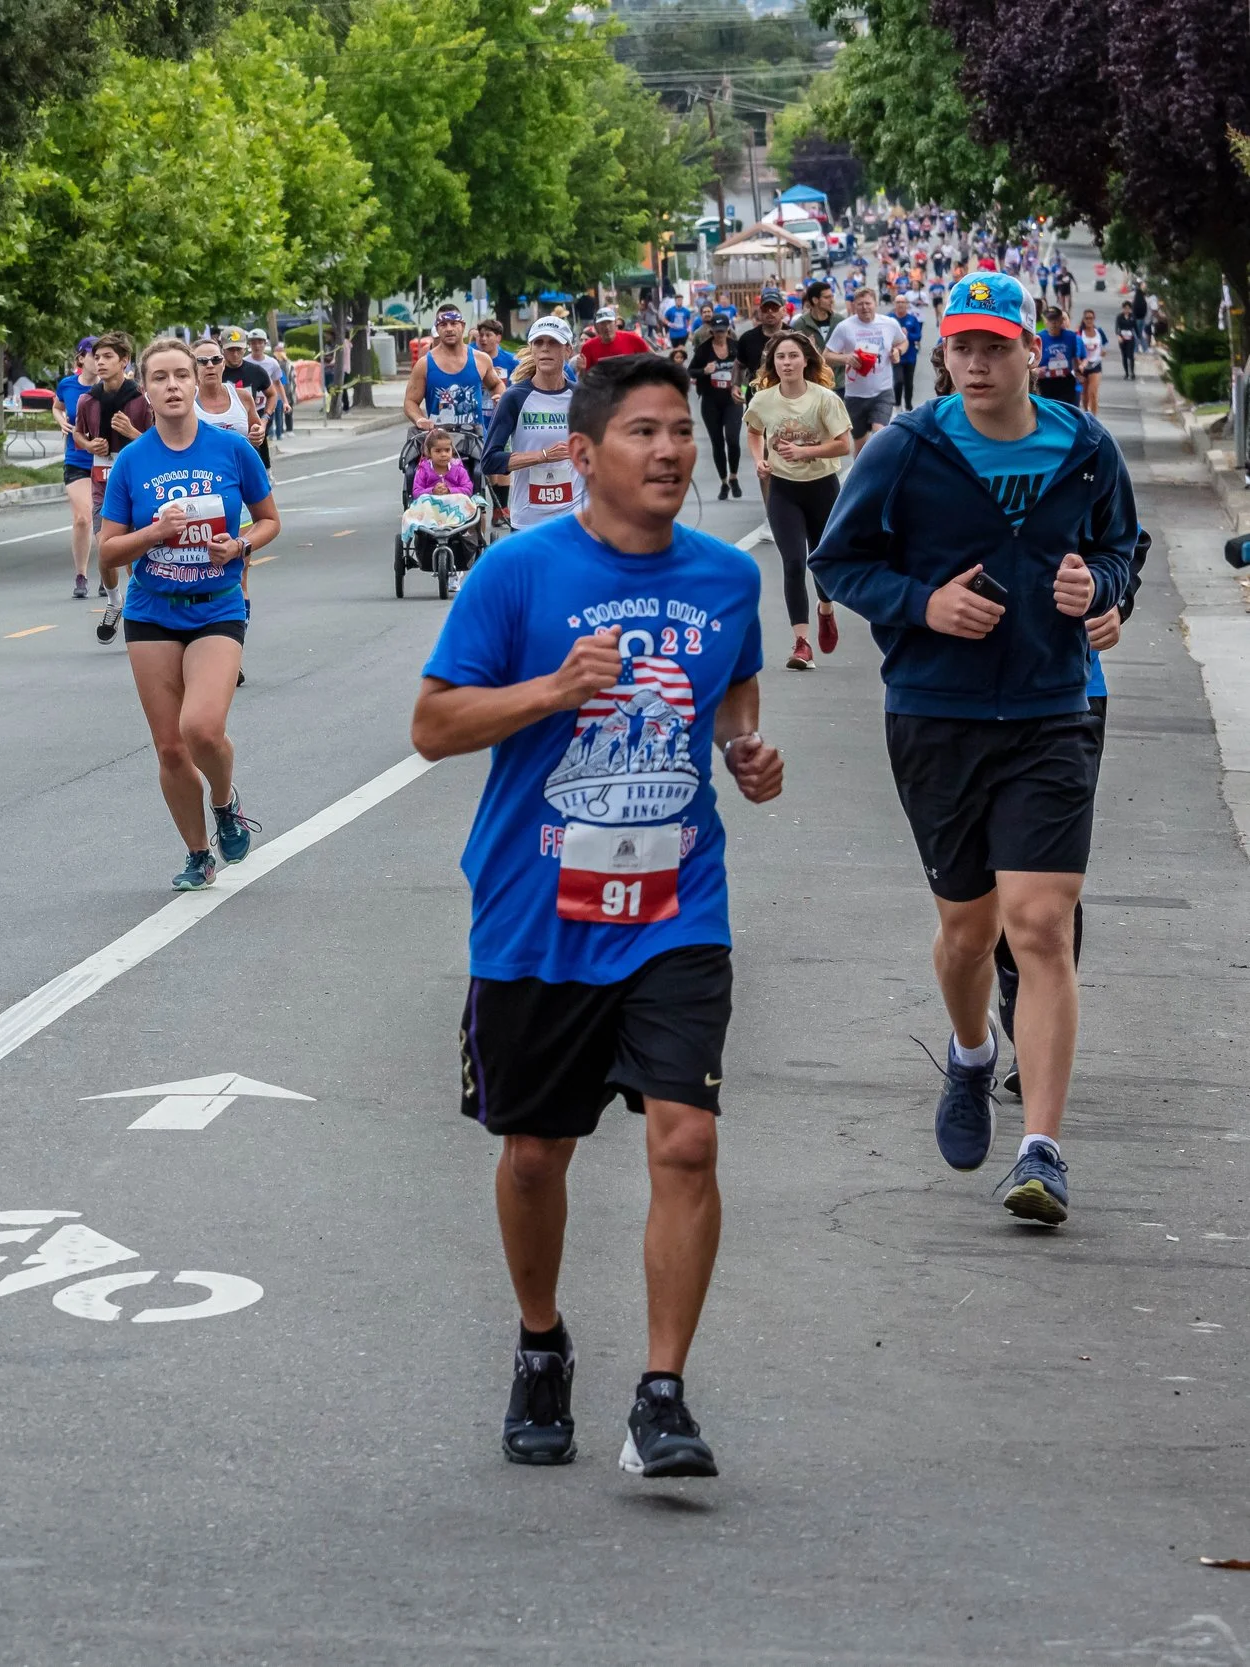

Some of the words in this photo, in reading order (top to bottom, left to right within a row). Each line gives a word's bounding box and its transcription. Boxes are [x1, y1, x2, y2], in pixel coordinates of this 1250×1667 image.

[522, 413, 540, 424] LIZ
[150, 469, 189, 487] MORGAN
[191, 469, 214, 480] HILL
[537, 486, 564, 502] 459
[178, 523, 213, 545] 260
[179, 554, 204, 562] RING!
[582, 598, 660, 628] MORGAN
[666, 599, 708, 629] HILL
[562, 790, 589, 809] LET
[626, 785, 691, 801] FREEDOM
[621, 804, 667, 820] RING!
[600, 879, 643, 917] 91
